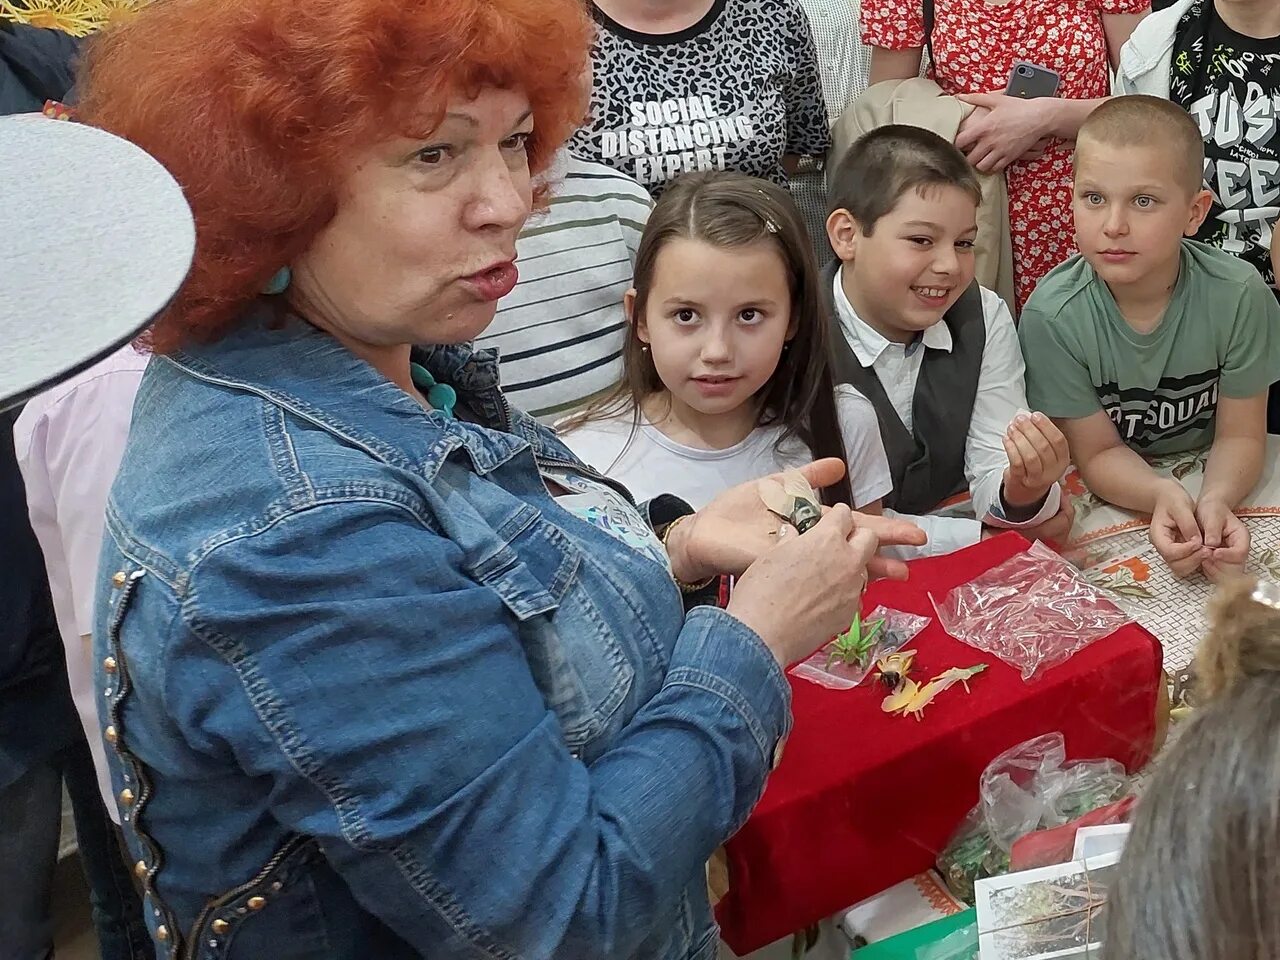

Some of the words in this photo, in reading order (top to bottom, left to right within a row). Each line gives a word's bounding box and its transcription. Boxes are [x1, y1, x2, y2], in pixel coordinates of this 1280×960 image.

[629, 95, 718, 127] SOCIAL
[601, 115, 754, 159] DISTANCING
[635, 146, 728, 184] EXPERT
